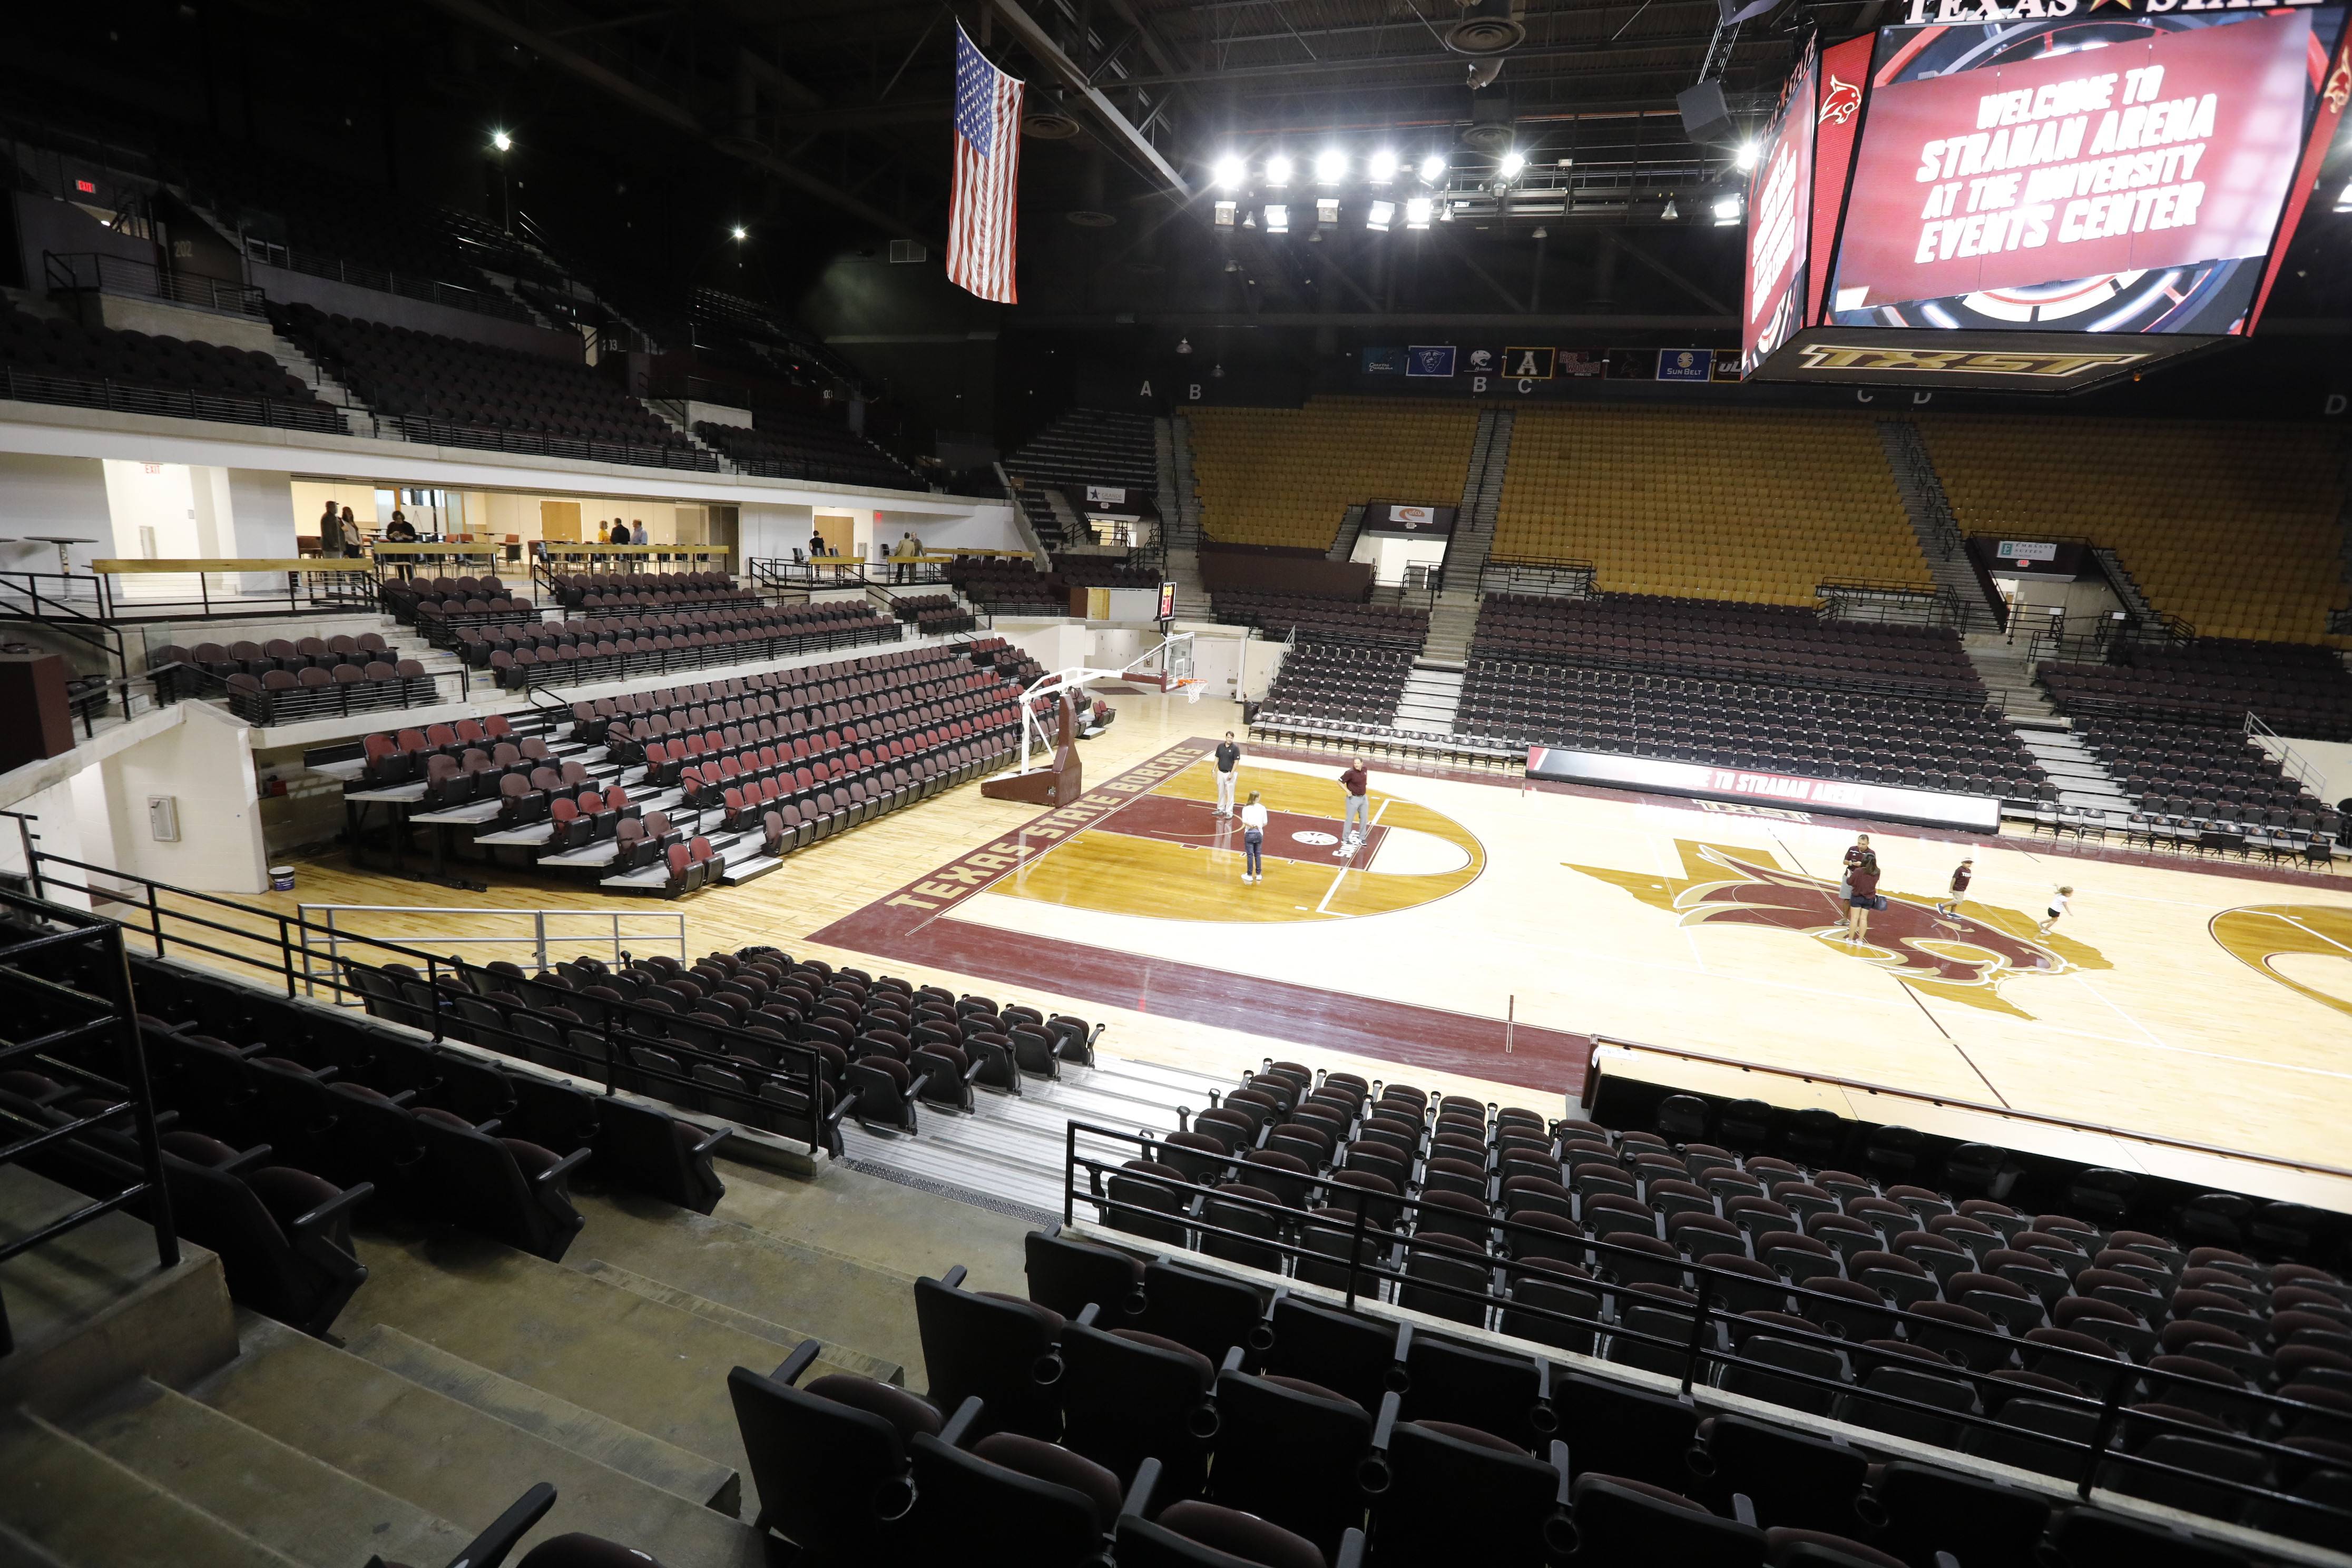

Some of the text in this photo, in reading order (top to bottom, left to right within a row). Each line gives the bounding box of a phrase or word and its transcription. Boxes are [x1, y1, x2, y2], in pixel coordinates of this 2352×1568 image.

[1977, 65, 2164, 129] WELCOME TO
[1916, 93, 2217, 182] STRAHAN ARENA
[1921, 143, 2206, 219] AT THE UNIVERSITY
[1915, 181, 2206, 263] EVENTS CENTER
[174, 240, 193, 257] 202
[1516, 351, 1537, 375] A
[1801, 345, 2150, 376] TXST
[1140, 380, 1152, 396] A
[1189, 384, 1201, 399] B
[1473, 377, 1487, 392] B
[1518, 378, 1533, 394] C
[1857, 390, 1873, 403] C
[2325, 395, 2347, 414] D
[145, 464, 160, 474] EXIT
[1714, 771, 1736, 790] TO
[1737, 774, 1811, 799] STRAHAN
[1691, 799, 1812, 824] TXST
[885, 747, 1206, 909] TEXAS STATE BOBCATS
